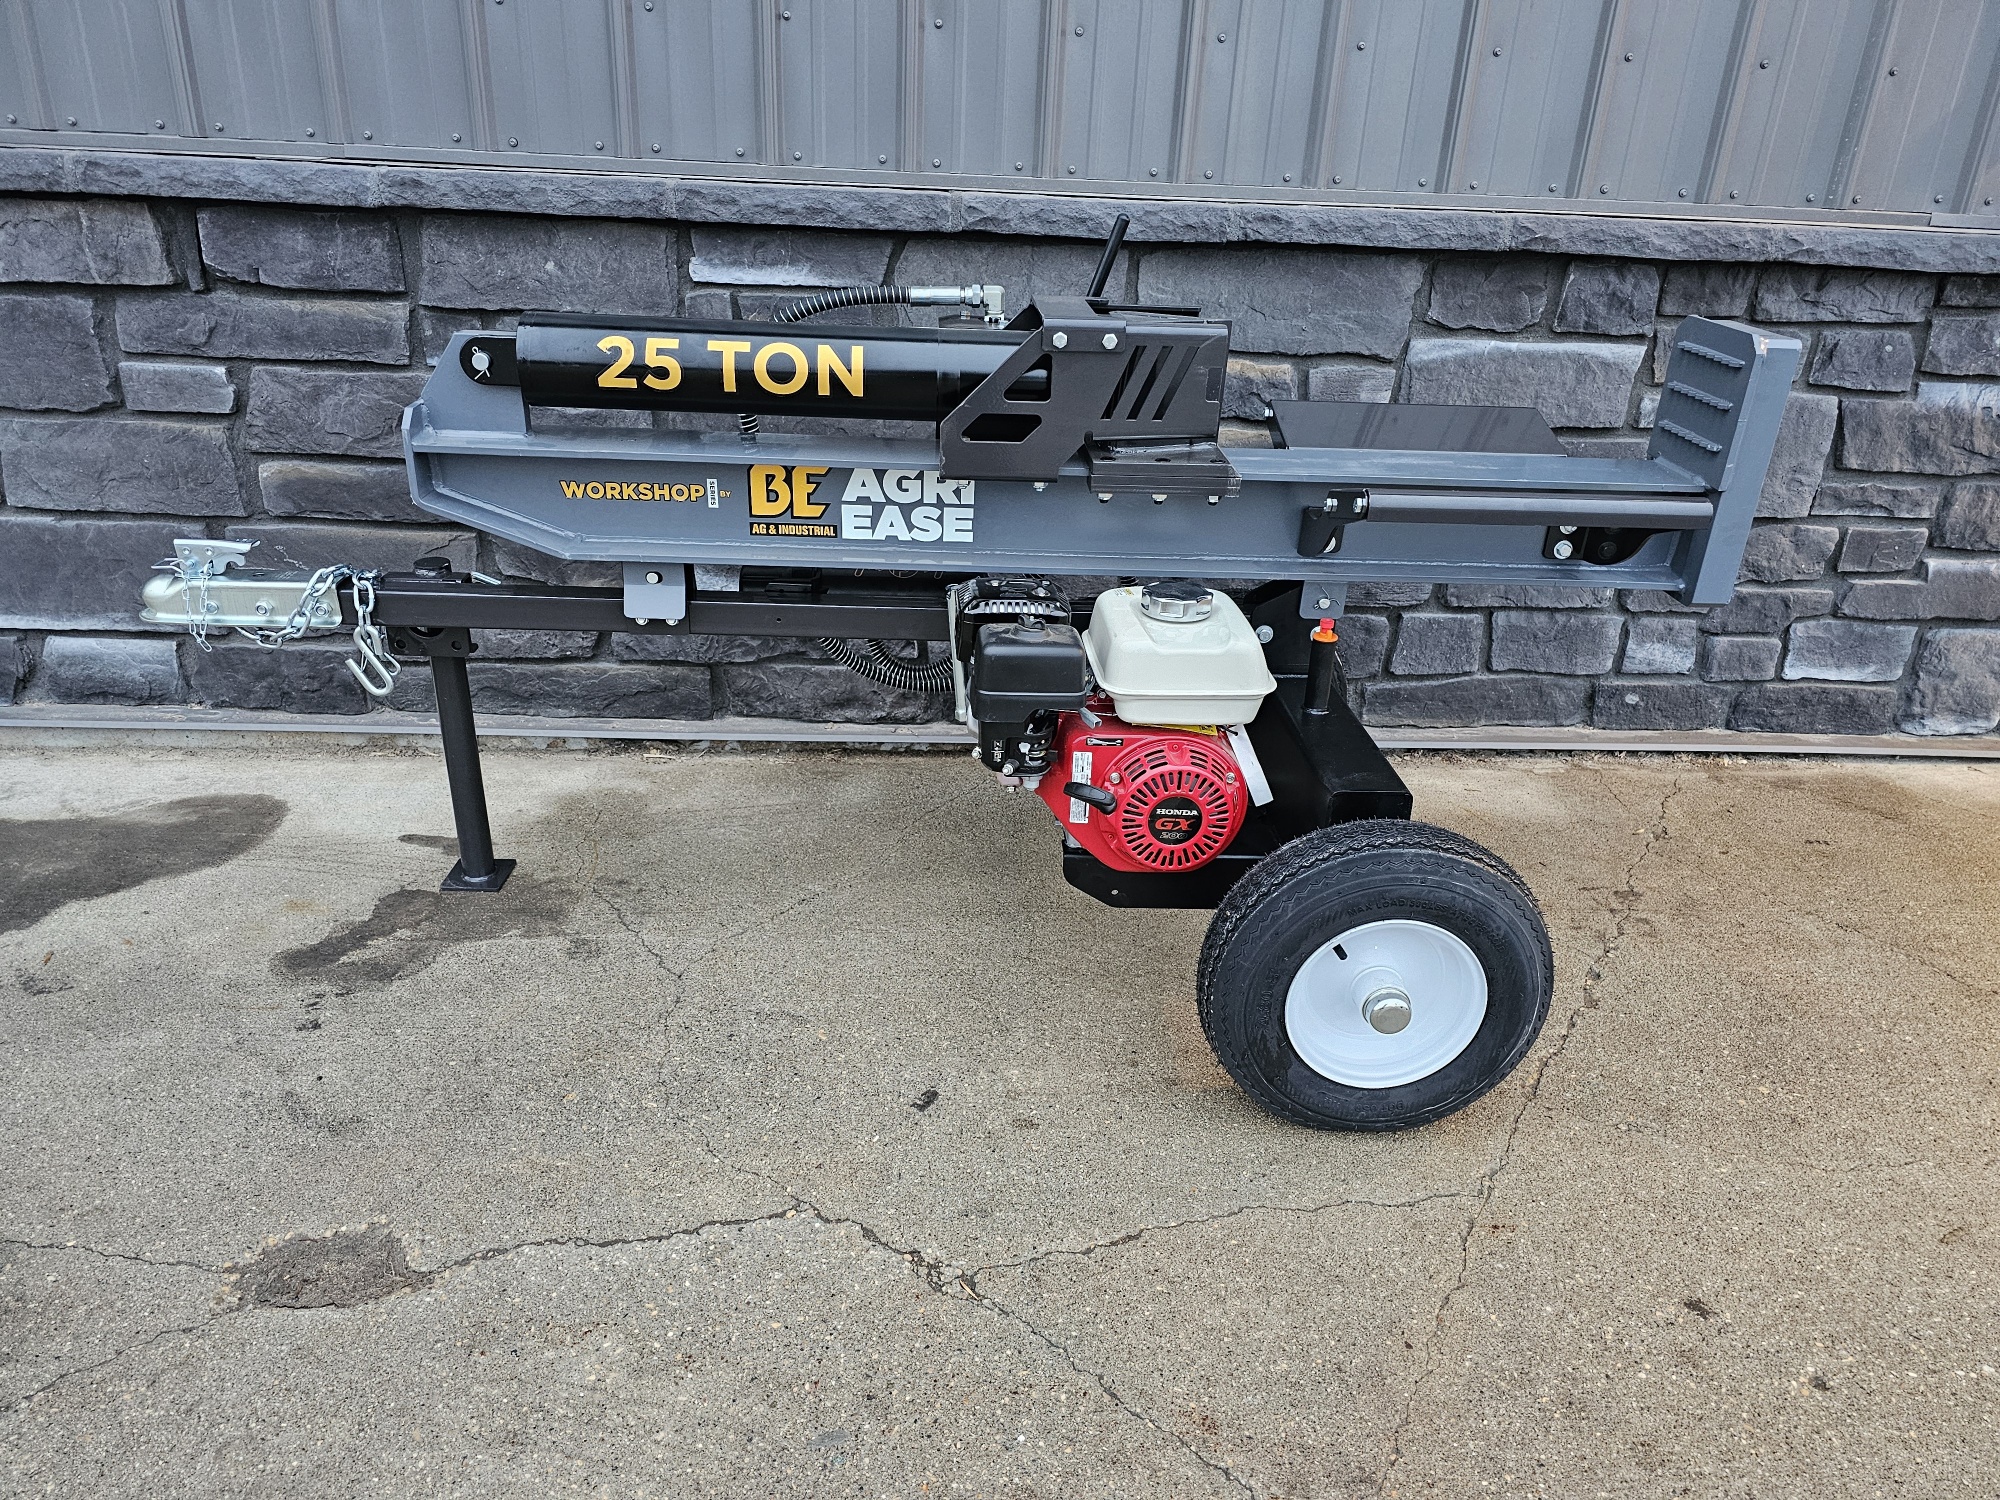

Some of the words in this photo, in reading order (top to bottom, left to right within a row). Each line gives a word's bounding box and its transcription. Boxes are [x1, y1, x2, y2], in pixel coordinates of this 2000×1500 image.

[597, 335, 682, 391] 25
[707, 340, 864, 397] TON
[560, 480, 705, 502] WORKSHOP
[709, 480, 717, 506] SERIES
[719, 490, 732, 498] BY
[750, 464, 831, 518] BE
[841, 467, 975, 505] AGRI
[752, 523, 767, 535] AG
[769, 524, 776, 535] &
[778, 524, 836, 537] INDUSTRIAL
[841, 504, 975, 543] EASE
[1156, 808, 1199, 816] HONDA
[1155, 817, 1196, 831] GX
[1159, 831, 1188, 840] 200
[1347, 903, 1373, 916] MAX
[1375, 898, 1406, 909] LOAD
